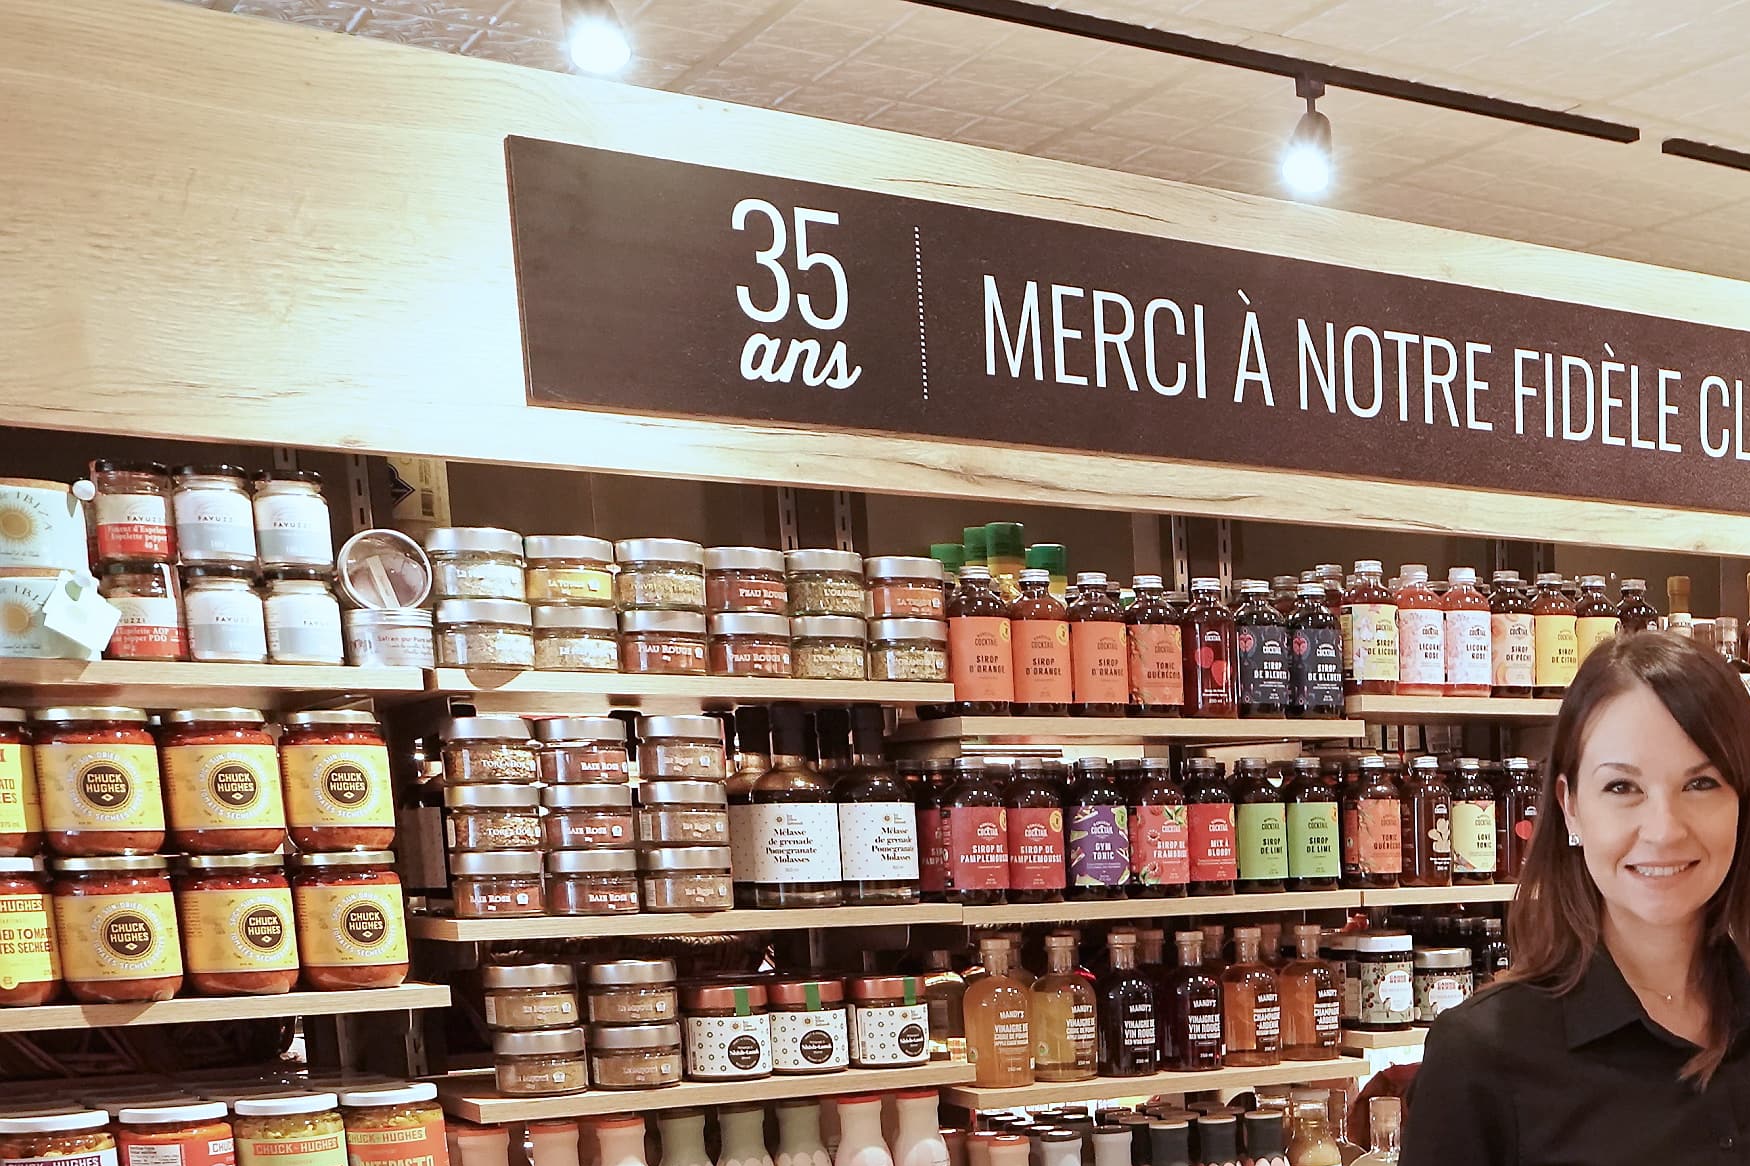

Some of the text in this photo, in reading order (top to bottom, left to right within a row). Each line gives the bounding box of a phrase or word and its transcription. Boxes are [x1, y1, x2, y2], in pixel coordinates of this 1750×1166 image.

[731, 198, 850, 330] 35
[739, 332, 861, 389] ans
[983, 275, 1206, 399] MERCI
[1233, 290, 1275, 406] À
[1297, 320, 1492, 432] NOTRE
[1513, 342, 1681, 453] FIDÈLE
[1033, 658, 1054, 666] SIROP
[1099, 659, 1118, 667] SIROP
[87, 773, 122, 784] CHUCK
[218, 773, 251, 783] CHUCK
[330, 772, 363, 783] CHUCK
[86, 783, 126, 793] HUGHES
[217, 782, 254, 793] HUGHES
[329, 781, 366, 792] HUGHES
[768, 837, 778, 846] de
[1263, 838, 1280, 846] SIROP
[972, 845, 994, 853] SIROP
[1020, 846, 1043, 854] SIROP
[1093, 852, 1114, 860] TONIC
[248, 916, 278, 926] CHUCK
[350, 912, 381, 923] CHUCK
[111, 922, 145, 933] CHUCK
[247, 924, 282, 936] HUGHES
[348, 921, 384, 931] HUGHES
[110, 932, 149, 942] HUGHES
[383, 1129, 423, 1143] HUGHES
[256, 1138, 338, 1155] CHUCK HUGHES
